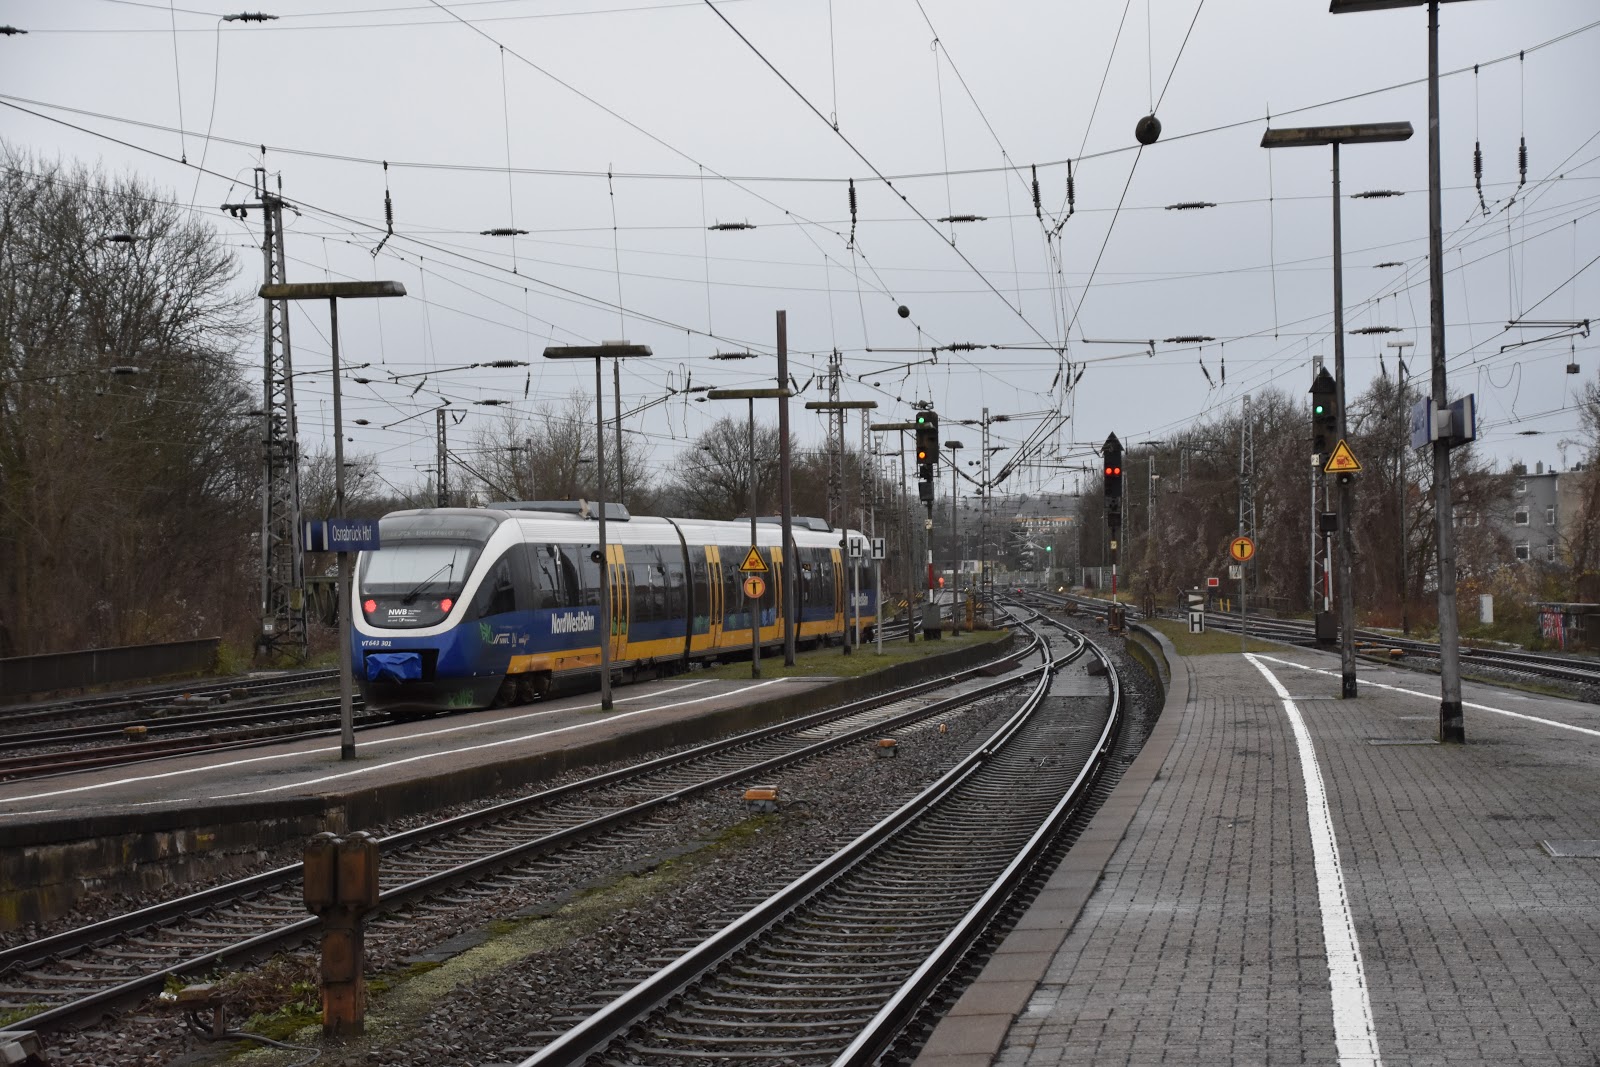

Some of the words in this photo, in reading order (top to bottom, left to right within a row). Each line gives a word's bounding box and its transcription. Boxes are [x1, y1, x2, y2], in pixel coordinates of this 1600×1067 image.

[332, 525, 362, 541] Osnabrück
[362, 525, 372, 541] Hbf
[553, 544, 561, 565] 2
[851, 539, 861, 555] H
[872, 540, 883, 557] H
[388, 608, 408, 616] NWB
[551, 611, 595, 634] NordWestBahn
[1191, 614, 1202, 632] H
